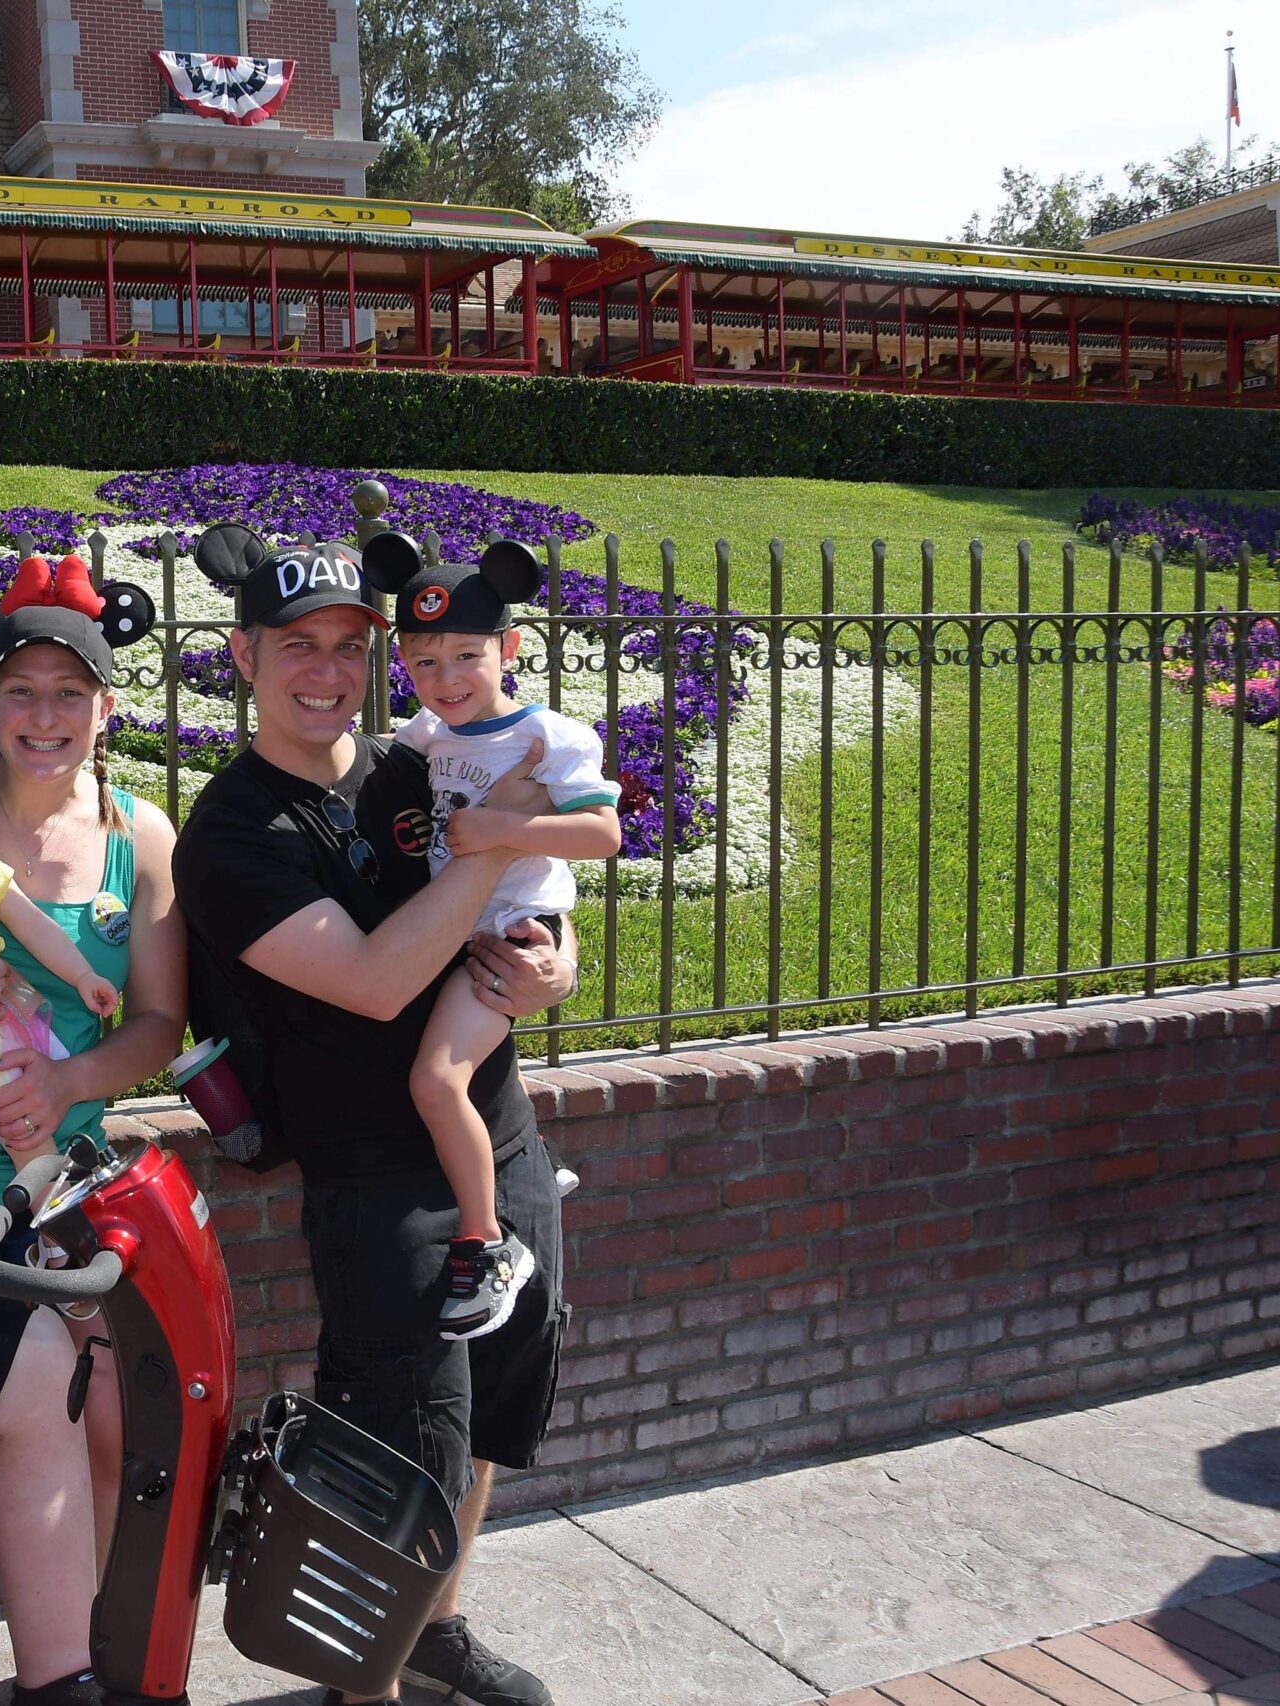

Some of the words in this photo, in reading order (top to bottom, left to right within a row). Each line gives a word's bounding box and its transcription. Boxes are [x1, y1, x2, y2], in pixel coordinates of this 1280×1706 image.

[98, 193, 376, 221] RAILROAD
[823, 242, 1069, 271] DISNEYLAND
[1122, 266, 1277, 285] RAILROA
[273, 551, 310, 563] Disney
[276, 556, 361, 598] DAD
[432, 756, 454, 777] TLE
[106, 918, 130, 940] Chelsea
